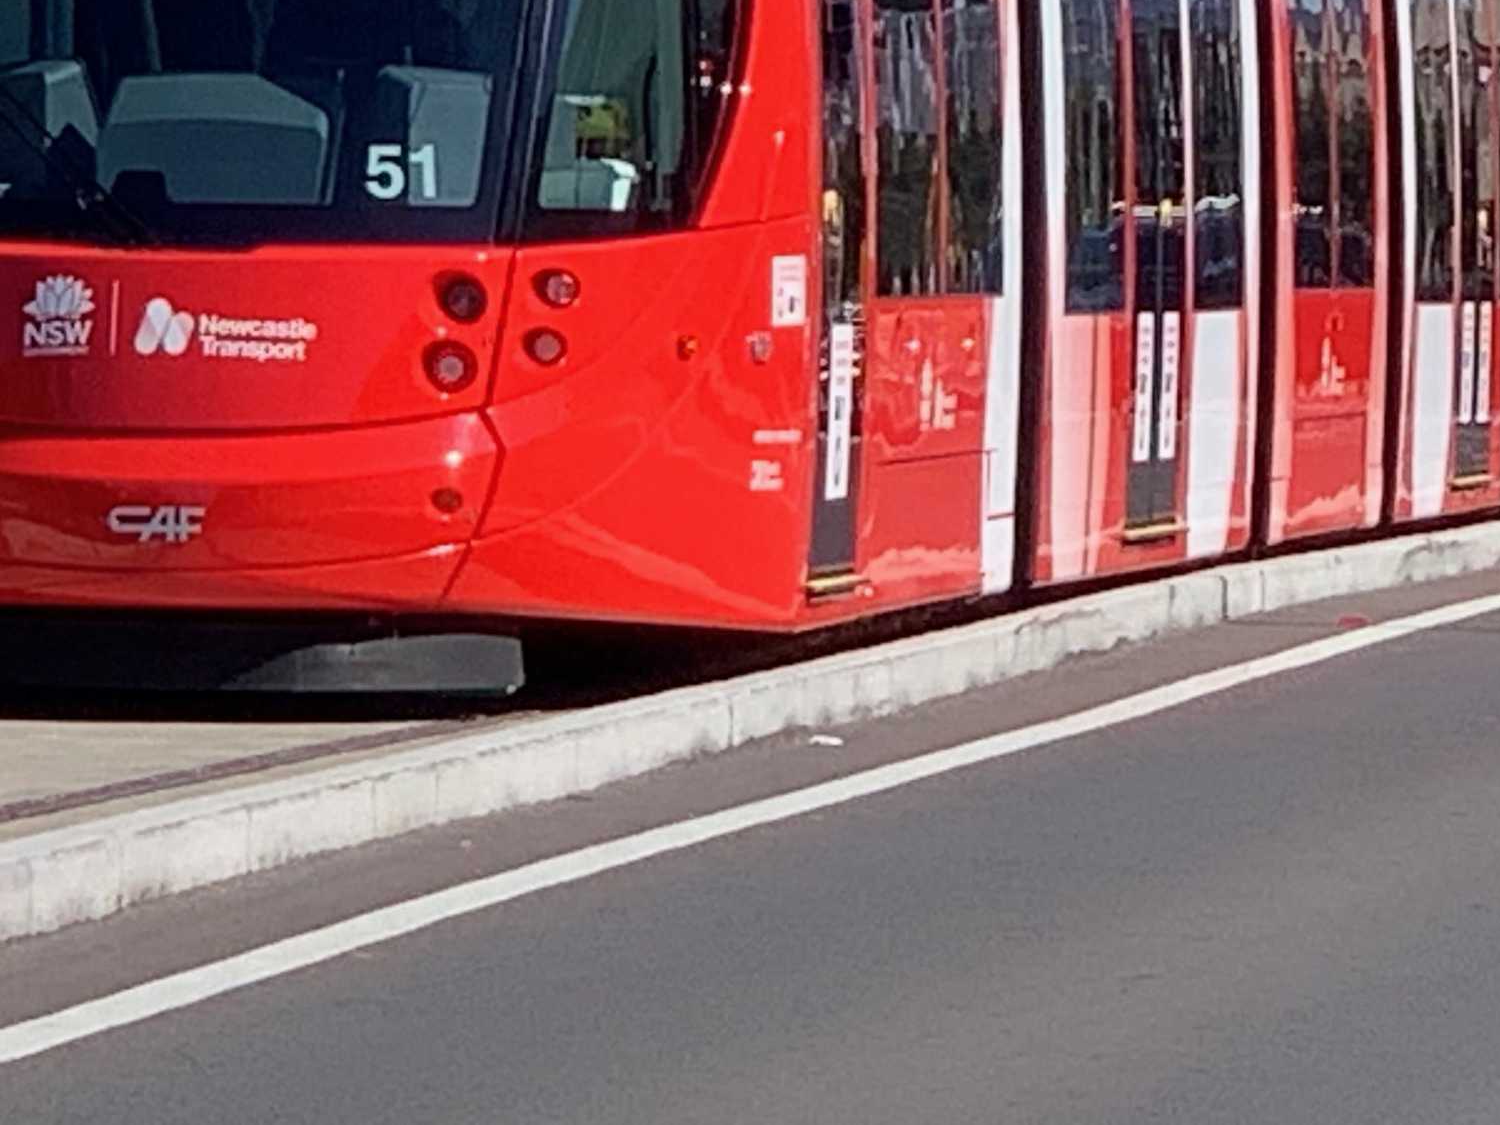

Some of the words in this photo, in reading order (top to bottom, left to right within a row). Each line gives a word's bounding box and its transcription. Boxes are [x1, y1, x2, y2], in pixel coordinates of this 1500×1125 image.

[366, 143, 437, 199] 51
[24, 320, 93, 346] NSW
[199, 313, 317, 340] Newcastle
[200, 335, 306, 363] Transport
[106, 505, 206, 542] CAF
